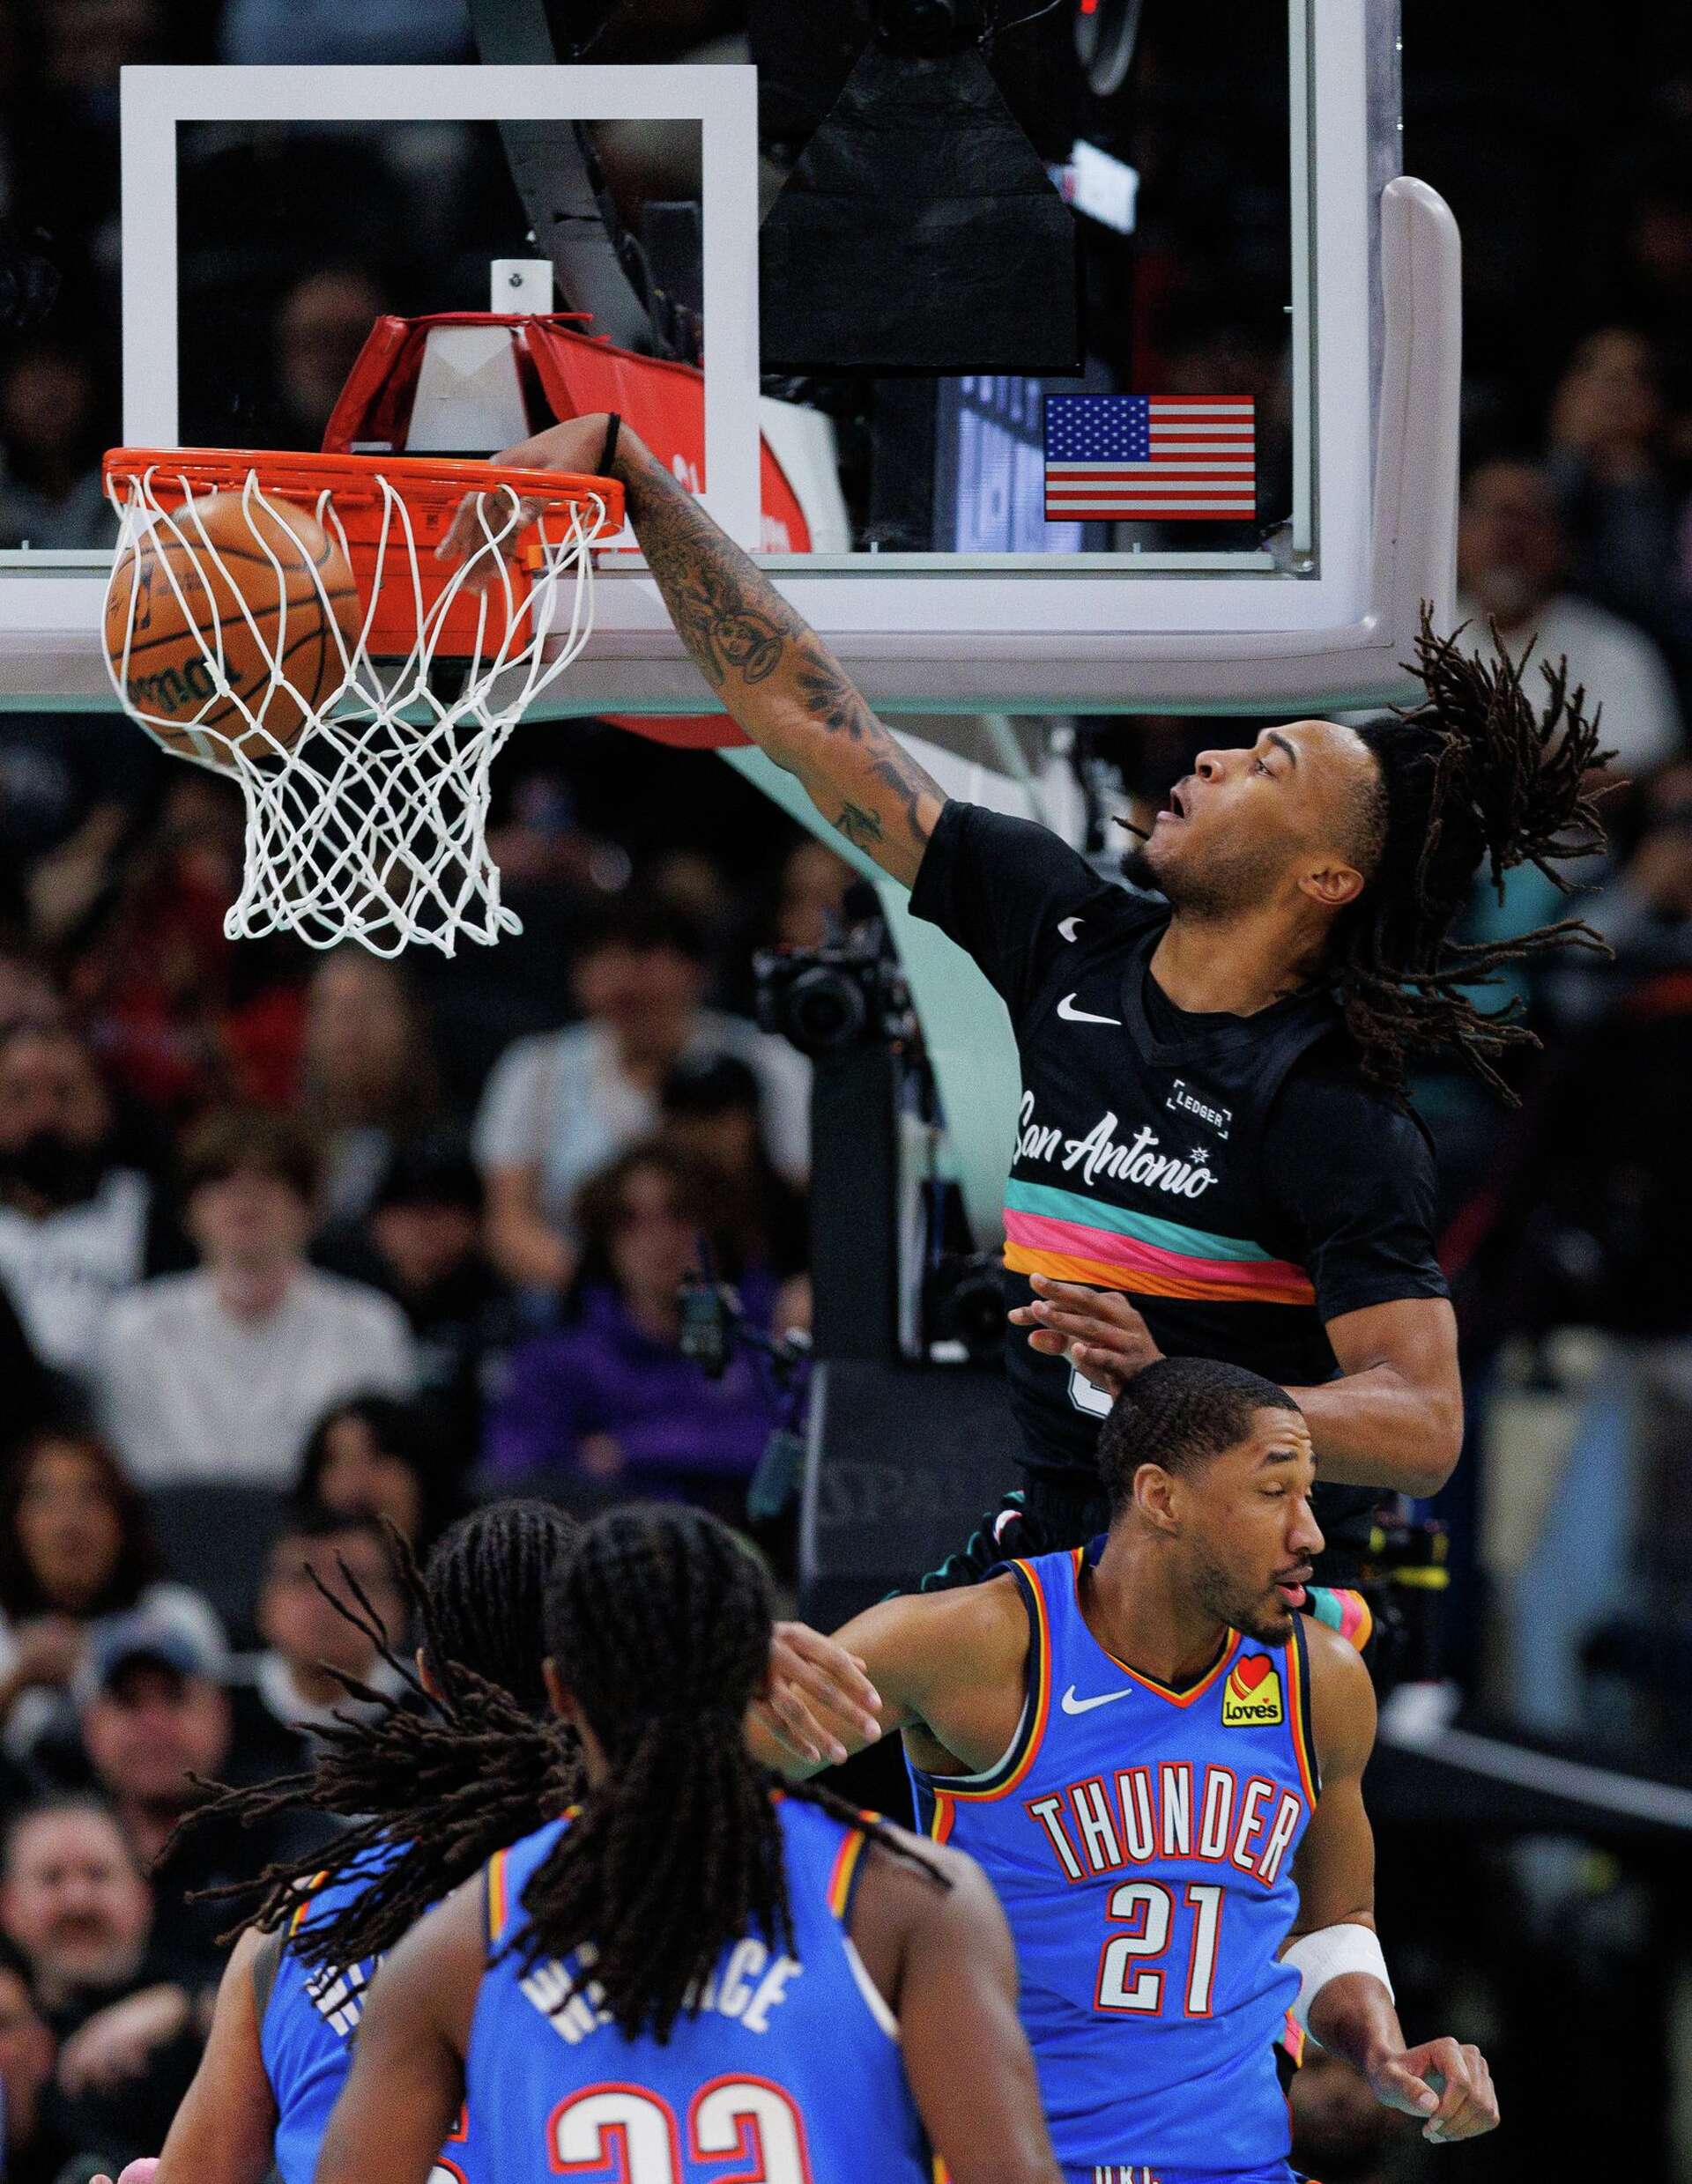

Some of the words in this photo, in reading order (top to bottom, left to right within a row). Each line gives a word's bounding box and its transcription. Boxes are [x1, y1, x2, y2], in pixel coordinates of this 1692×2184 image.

[1013, 1090, 1063, 1166] San
[1061, 1110, 1220, 1198] Antonio
[1176, 1091, 1224, 1129] LEDGER
[1025, 1762, 1302, 1889] THUNDER
[1095, 1879, 1224, 2017] 21
